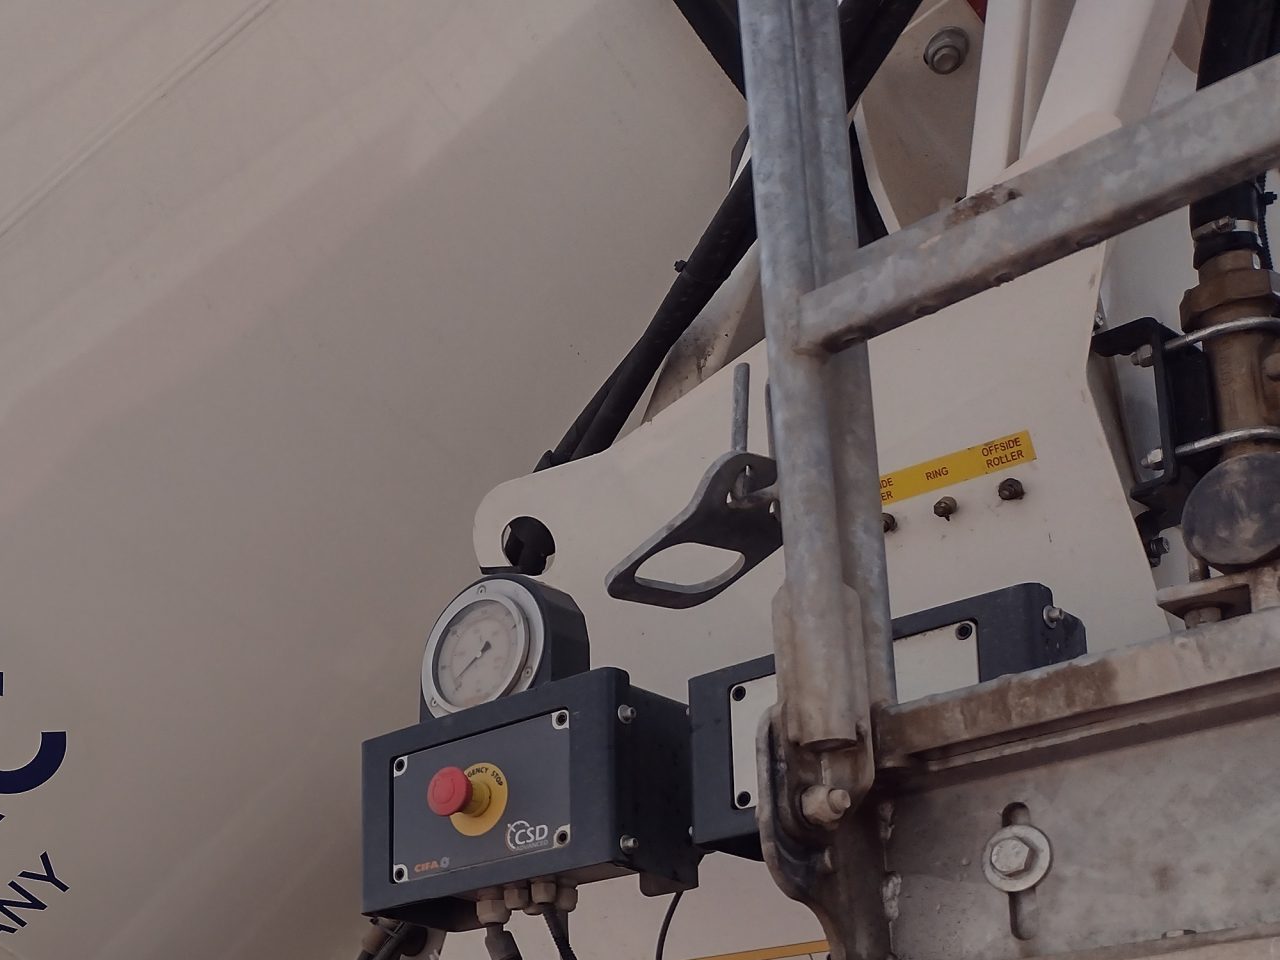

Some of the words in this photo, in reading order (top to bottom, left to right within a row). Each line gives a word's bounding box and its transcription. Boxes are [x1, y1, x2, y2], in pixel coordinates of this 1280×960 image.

[981, 437, 1022, 458] OFFSIDE
[986, 449, 1024, 469] ROLLER
[925, 467, 949, 481] RING
[467, 766, 489, 778] GENCY
[491, 770, 504, 786] STOP
[515, 824, 549, 845] CSD
[414, 860, 439, 873] CIFA
